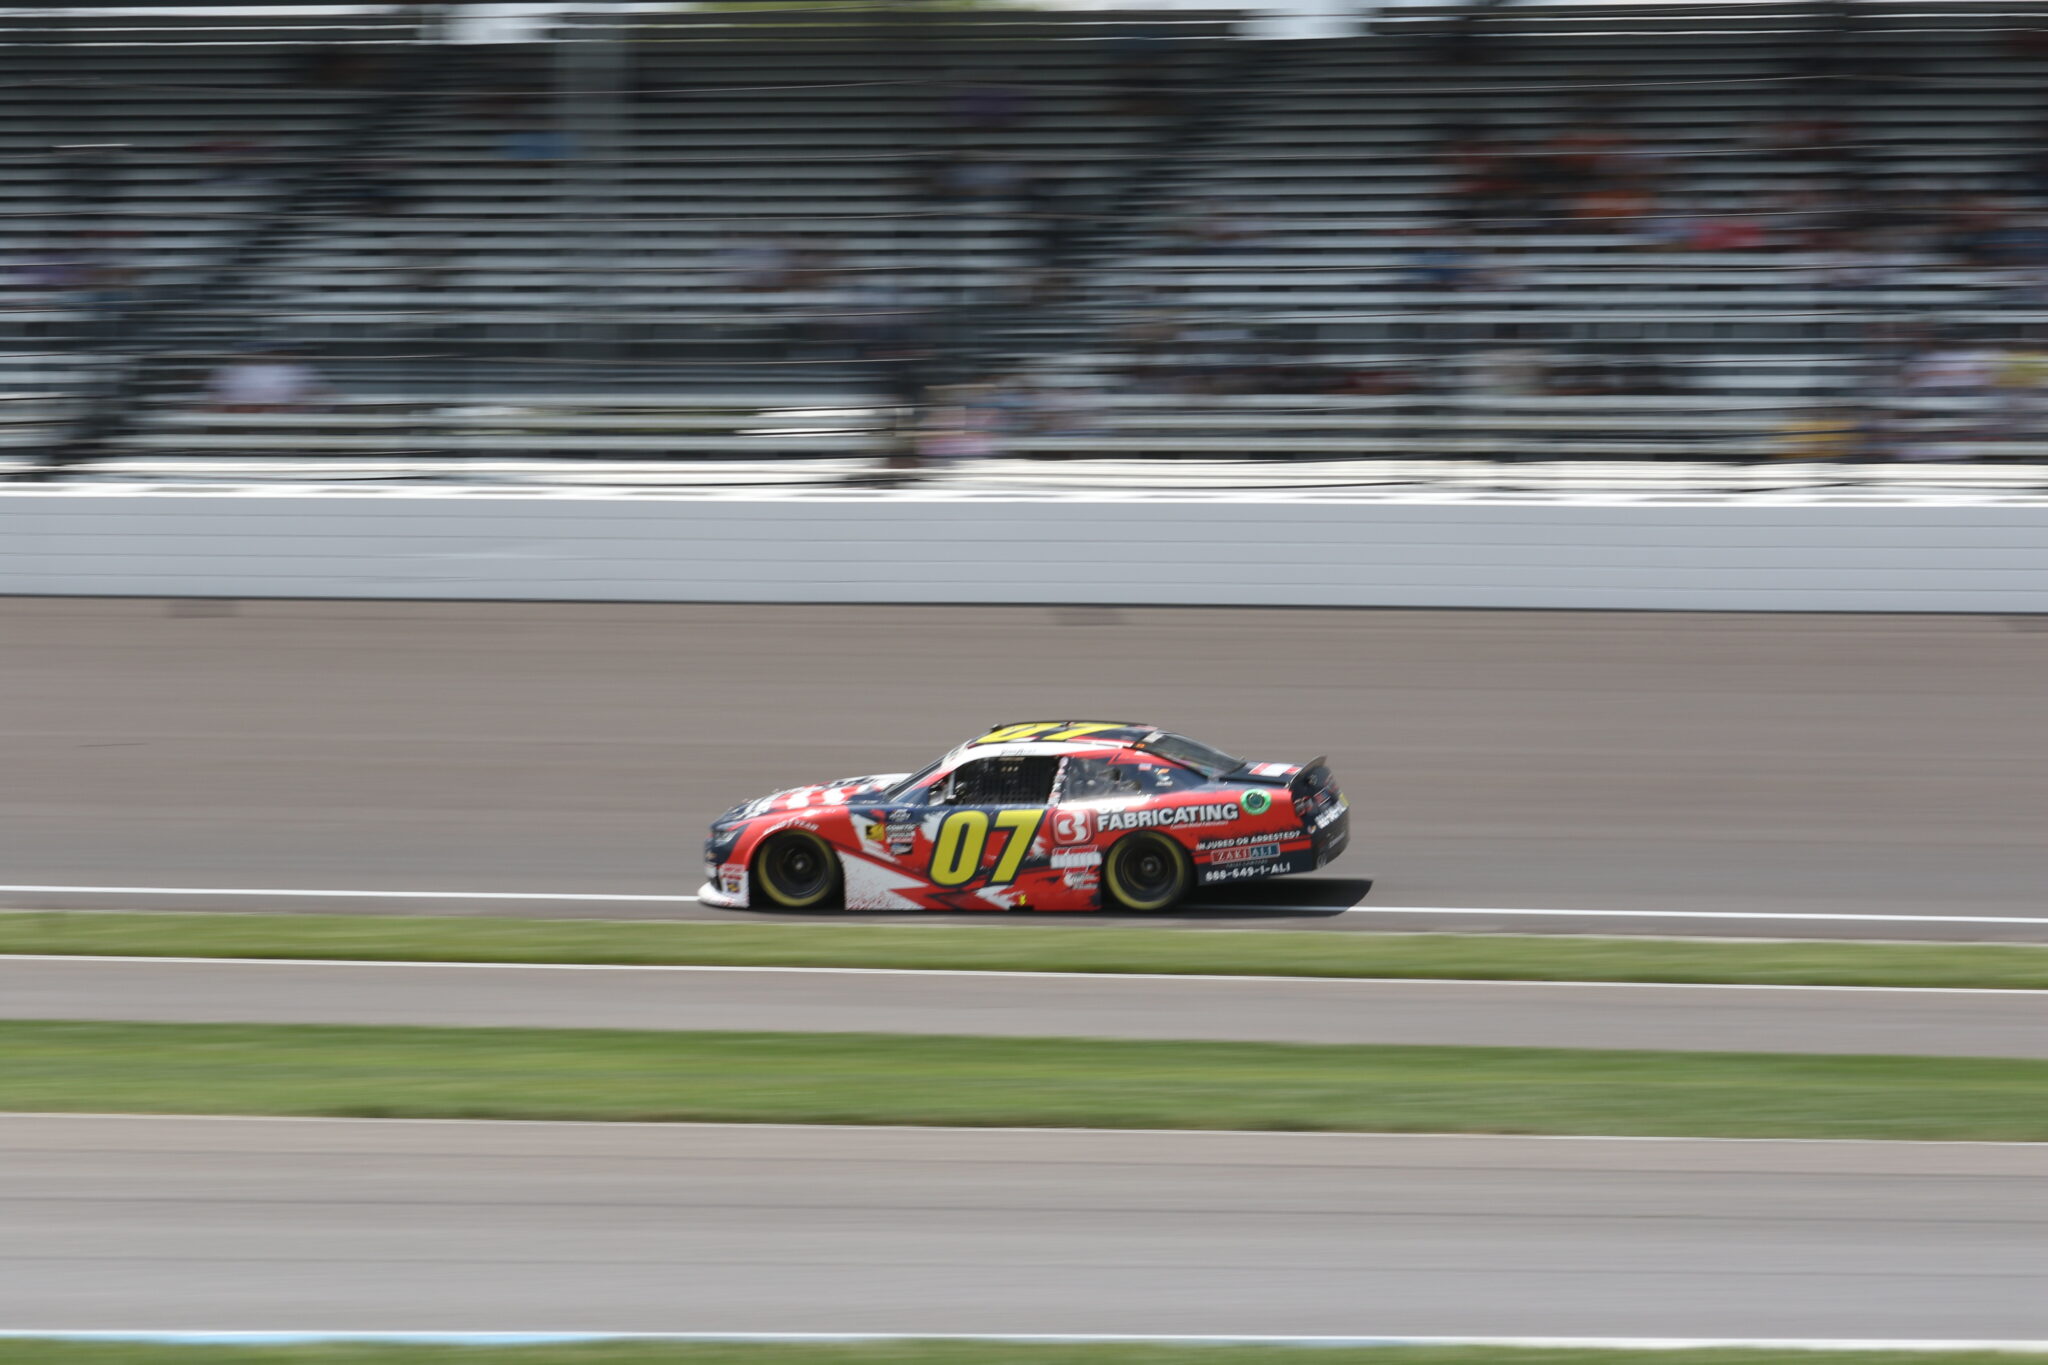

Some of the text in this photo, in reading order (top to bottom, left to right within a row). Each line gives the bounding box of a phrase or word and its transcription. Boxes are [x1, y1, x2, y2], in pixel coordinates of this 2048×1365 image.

[1097, 803, 1239, 832] FABRICATING
[930, 809, 1046, 886] 07
[1196, 830, 1301, 851] INJURED OR ARRESTED?
